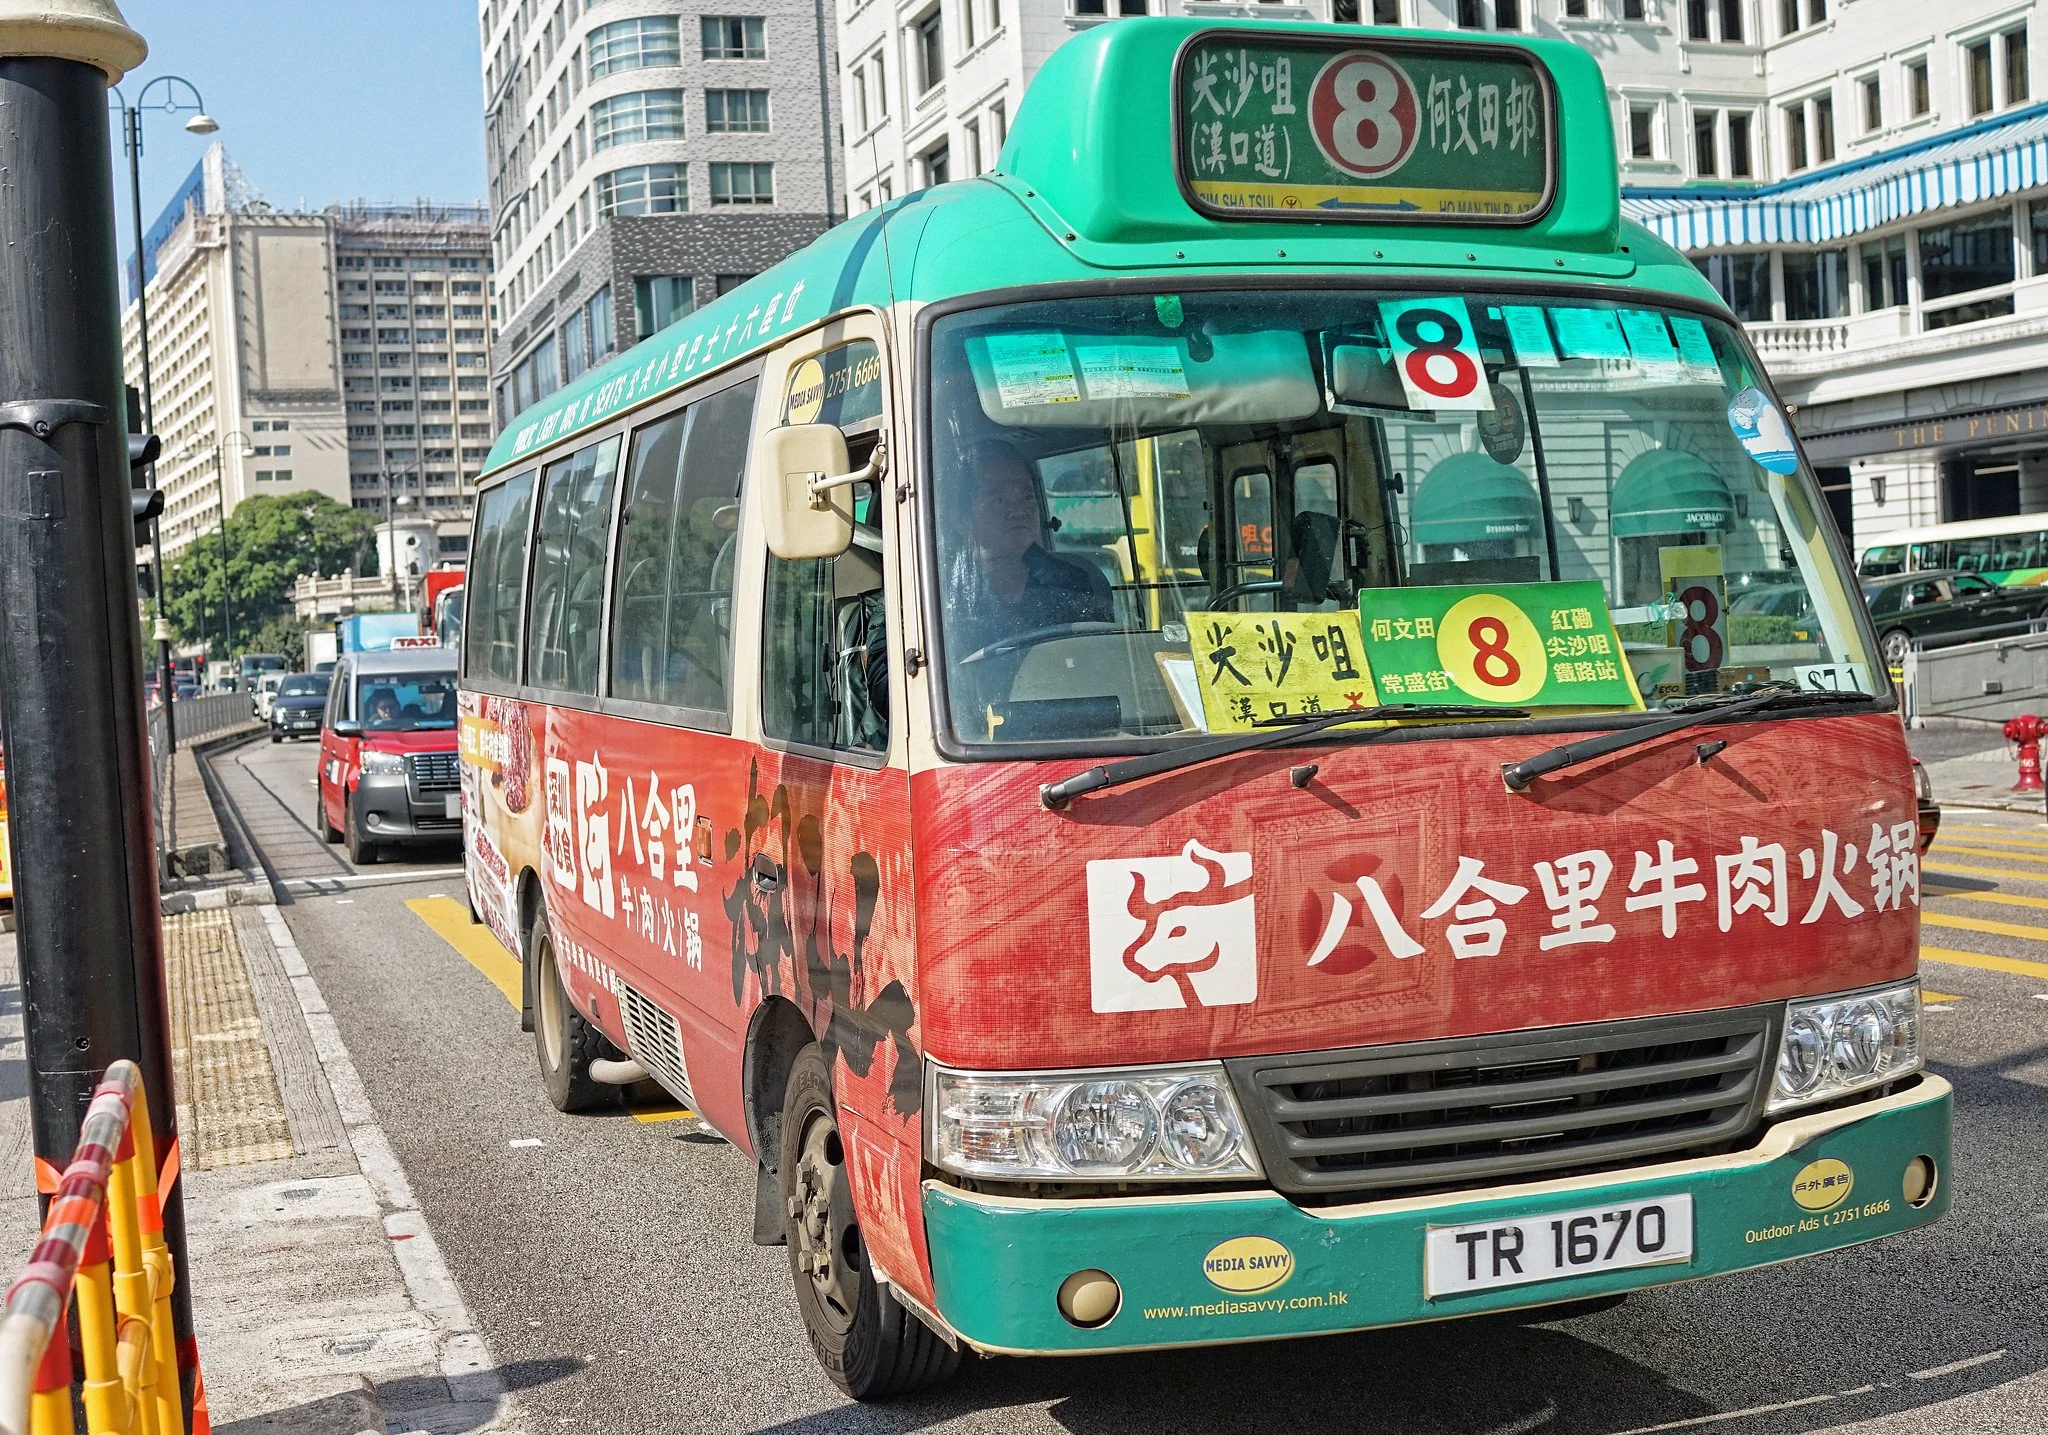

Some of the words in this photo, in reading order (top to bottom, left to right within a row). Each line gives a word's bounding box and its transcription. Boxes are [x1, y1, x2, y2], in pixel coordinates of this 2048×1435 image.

[1190, 49, 1296, 118] 尖沙咀
[1332, 61, 1403, 167] 8
[1426, 73, 1537, 158] 何文田邨
[626, 278, 805, 400] 公共小型巴士十六座位
[1395, 307, 1479, 399] 8
[592, 374, 628, 417] SEATS
[788, 388, 806, 411] MEDIA
[806, 382, 824, 405] SAVVY
[826, 366, 852, 399] 2751
[854, 353, 880, 388] 6666
[1895, 423, 1945, 448] THE
[1371, 617, 1436, 642] 何文田
[1550, 607, 1593, 631] 紅磡
[395, 637, 437, 647] TAXI
[1206, 620, 1361, 688] 尖沙咀
[1468, 616, 1521, 687] 8
[1547, 634, 1612, 657] 尖沙咀
[1381, 670, 1449, 695] 常盛街
[1553, 660, 1619, 684] 鐵路站
[617, 769, 698, 894] 八合里
[1307, 820, 1920, 966] 八合里牛肉火锅
[1793, 1173, 1849, 1194] 戶外廣告
[1455, 1225, 1524, 1281] TR
[1550, 1204, 1666, 1269] 1670
[1745, 1222, 1796, 1244] Outdoor
[1797, 1216, 1820, 1234] Ads
[1833, 1206, 1860, 1226] 2751
[1863, 1199, 1890, 1218] 6666
[1205, 1257, 1246, 1273] MEDIA
[1249, 1254, 1288, 1270] SAVVY
[1143, 1290, 1349, 1320] www.mediasavvy.com.hk
